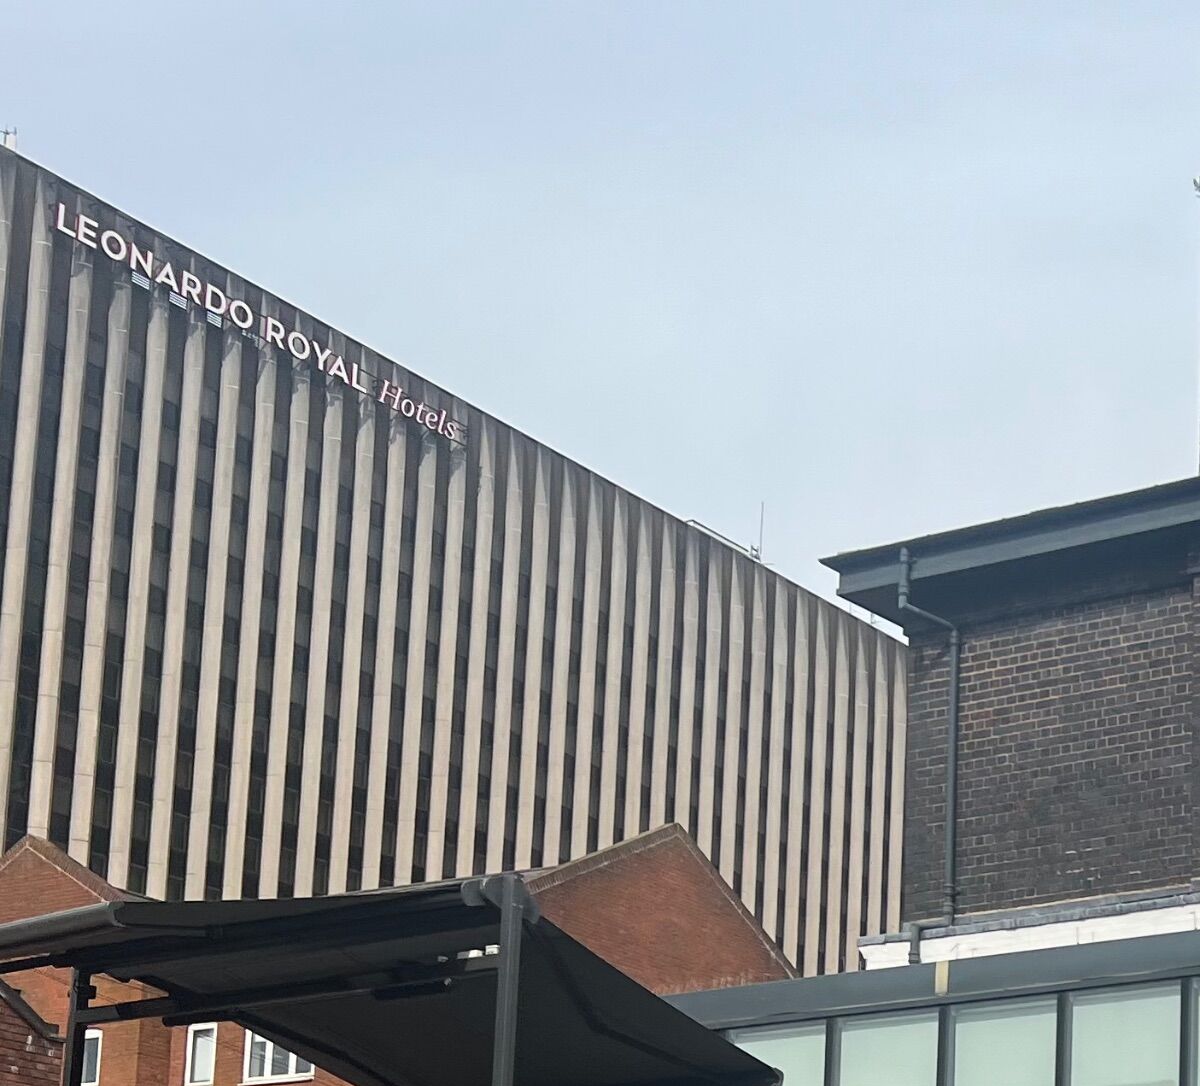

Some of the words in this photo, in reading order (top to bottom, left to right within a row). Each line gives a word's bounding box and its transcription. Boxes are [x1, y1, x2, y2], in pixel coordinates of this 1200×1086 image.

[57, 203, 254, 329] LEONARDO
[264, 316, 367, 394] ROYAL
[378, 379, 458, 440] Hotels
